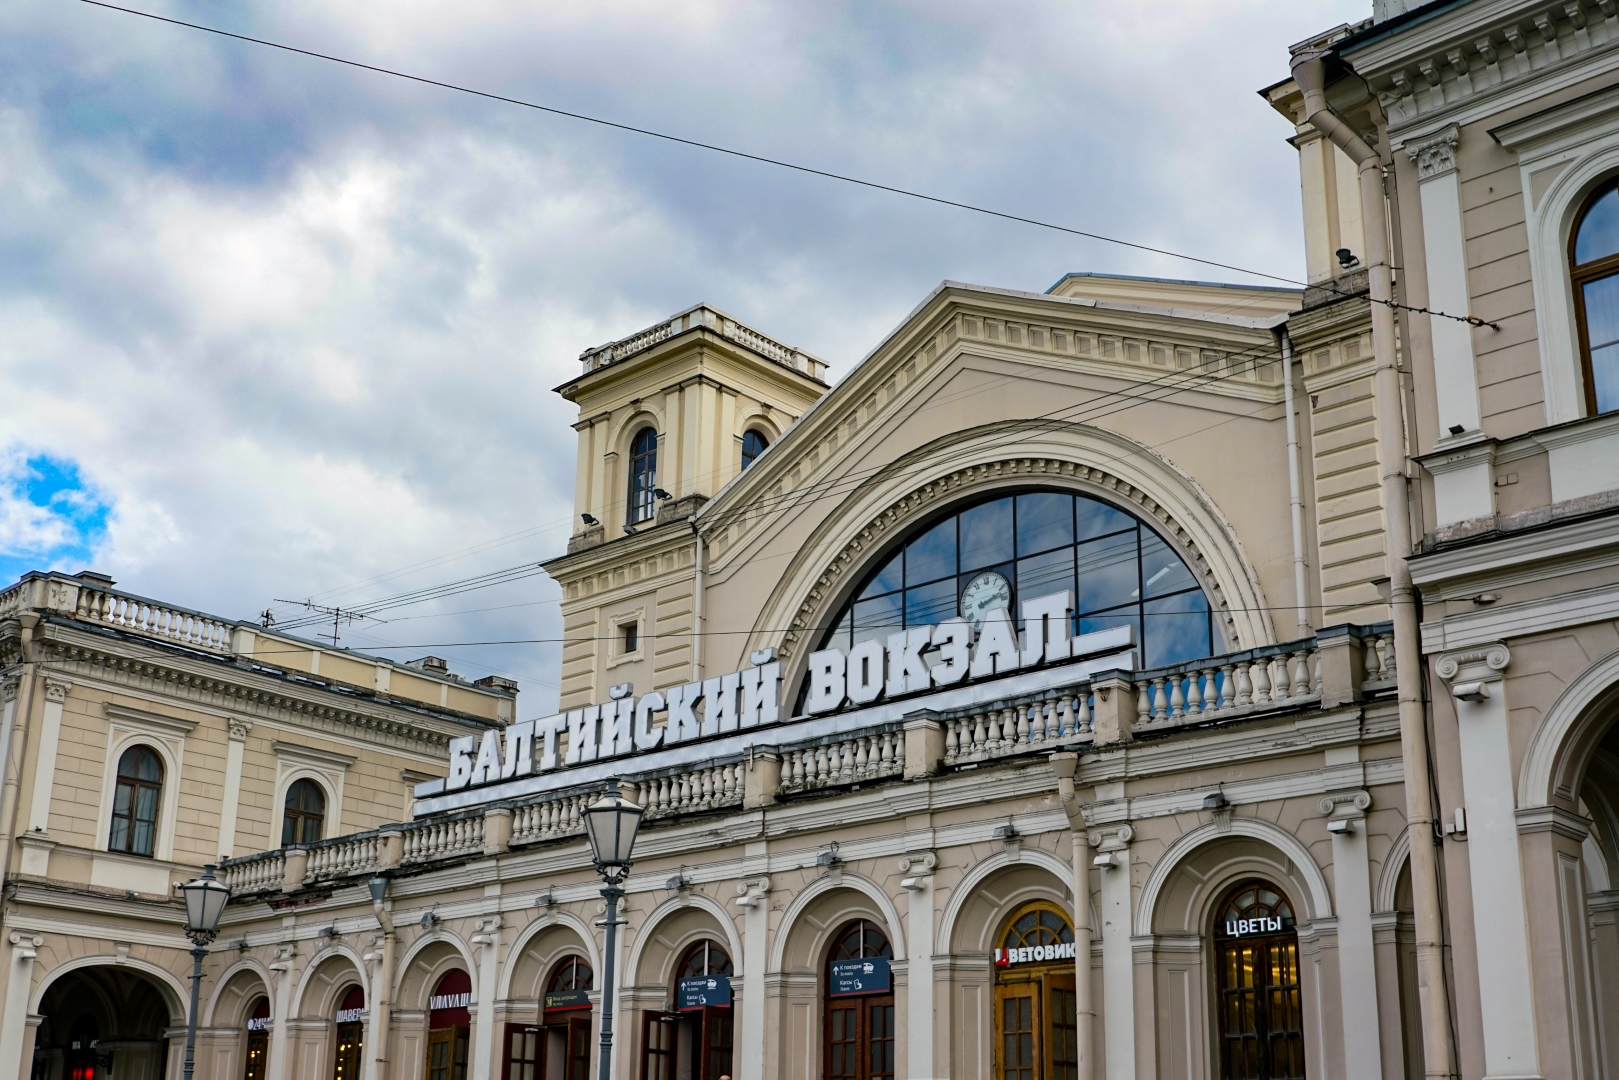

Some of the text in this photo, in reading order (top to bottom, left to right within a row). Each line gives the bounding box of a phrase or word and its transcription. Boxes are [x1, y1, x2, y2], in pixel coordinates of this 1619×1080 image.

[446, 589, 1075, 790] БАЛТИЙСКИЙ ВОКЗАЛ
[1226, 915, 1281, 938] ЦВЕТЫ
